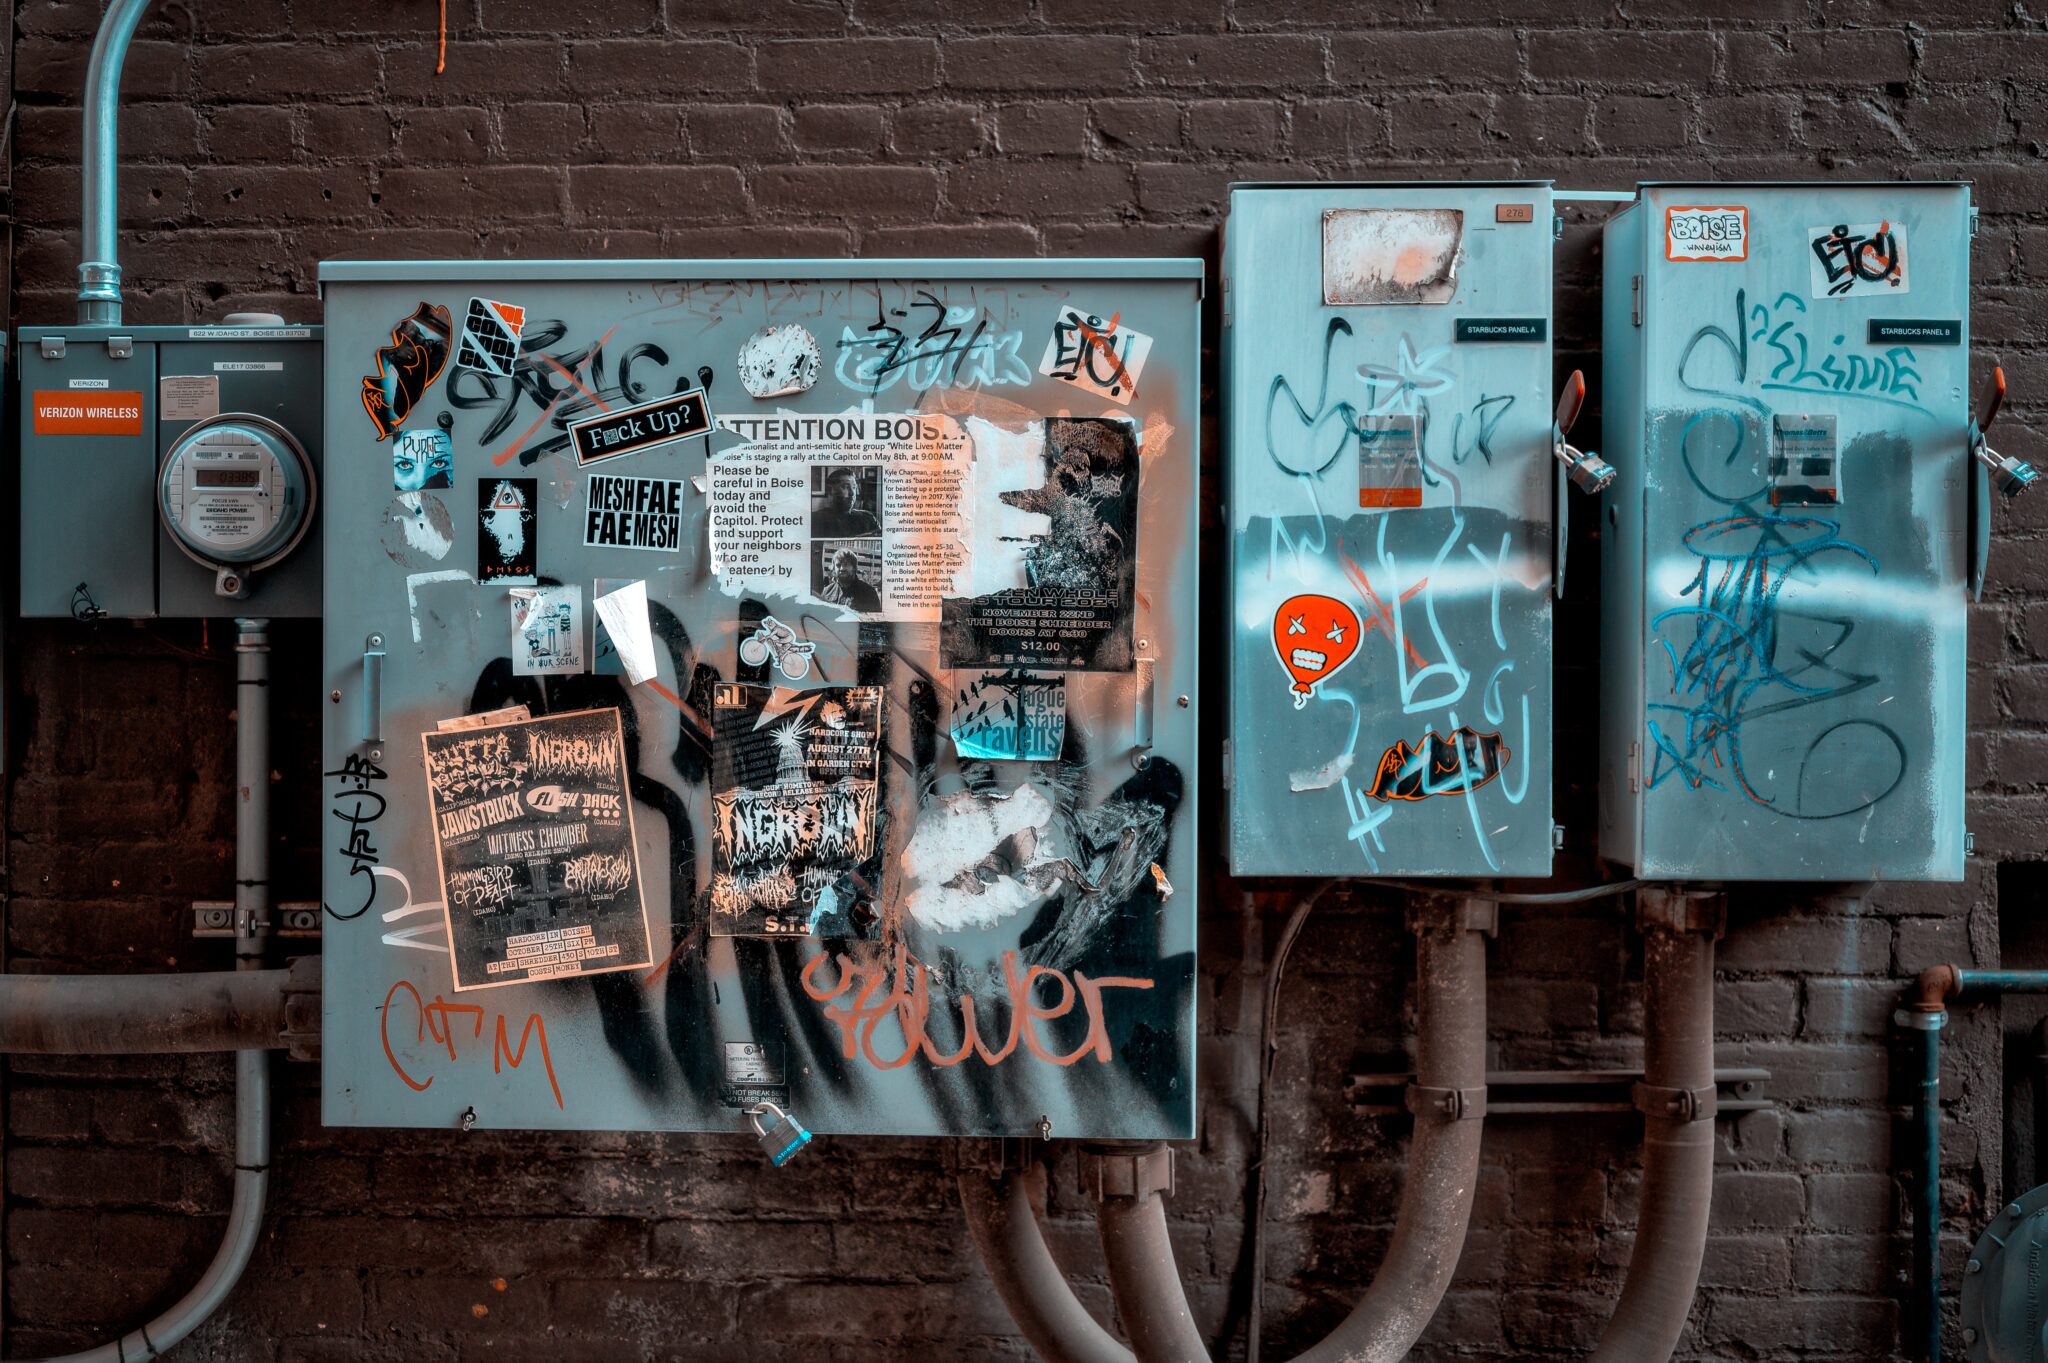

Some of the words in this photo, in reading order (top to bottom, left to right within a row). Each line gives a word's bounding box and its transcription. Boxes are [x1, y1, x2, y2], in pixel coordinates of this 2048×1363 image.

[1507, 209, 1523, 217] 278
[1467, 326, 1508, 334] STARBUCKS
[1508, 326, 1530, 334] PANEL
[1530, 326, 1537, 334] A
[1881, 328, 1921, 336] STARBUCKS
[1922, 328, 1944, 336] PANEL
[1945, 328, 1951, 336] B
[40, 407, 83, 418] VERIZON
[86, 407, 139, 418] WIRELESS
[588, 418, 645, 449] Fck
[646, 404, 691, 435] Up?
[718, 419, 865, 441] TTENTION
[780, 442, 794, 452] and
[796, 442, 842, 452] anti-semitic
[844, 442, 862, 452] hate
[863, 442, 886, 452] group
[888, 442, 913, 452] "White
[915, 442, 934, 452] Lives
[936, 442, 963, 452] Matter
[746, 453, 753, 462] is
[754, 453, 782, 462] staging
[783, 453, 788, 462] a
[790, 453, 806, 462] rally
[808, 453, 816, 462] at
[817, 453, 831, 462] the
[832, 453, 860, 462] Capitol
[862, 453, 873, 462] on
[874, 453, 891, 462] May
[893, 453, 909, 462] 8th,
[910, 453, 919, 462] at
[713, 465, 752, 476] Please
[755, 465, 770, 476] be
[713, 478, 753, 488] careful
[756, 478, 767, 488] in
[770, 478, 804, 488] Boise
[589, 476, 635, 511] MESH
[636, 479, 682, 514] FAE
[713, 490, 746, 502] today
[748, 490, 771, 500] and
[713, 503, 745, 513] avoid
[748, 503, 767, 513] the
[713, 515, 758, 528] Capitol.
[761, 515, 804, 526] Protect
[586, 511, 632, 546] FAE
[633, 513, 680, 549] MESH
[714, 528, 735, 538] and
[738, 528, 784, 540] support
[714, 542, 740, 552] your
[743, 541, 802, 552] neighbors
[714, 552, 737, 562] who
[740, 552, 759, 562] are
[778, 565, 793, 577] by
[993, 598, 1058, 607] TOUR
[982, 609, 1057, 618] NOVEMBER
[1059, 609, 1095, 618] 22ND
[966, 618, 993, 628] THE
[995, 618, 1037, 628] BOISE
[1039, 618, 1112, 628] SHREDDER
[988, 628, 1036, 637] DOORS
[1037, 628, 1057, 637] AT
[1021, 641, 1061, 651] $12.00
[556, 657, 580, 667] SCENE
[1026, 711, 1065, 730] state
[980, 725, 1060, 753] ravens
[807, 744, 846, 753] AUGUST
[846, 745, 871, 754] 27TH
[526, 729, 618, 782] INGROWN
[817, 760, 850, 768] GARDEN
[851, 760, 872, 768] CITY
[783, 788, 814, 797] RELEASE
[581, 794, 622, 809] BACK
[441, 791, 525, 840] JAWSTRUCK
[713, 784, 873, 868] INGROWN
[487, 829, 535, 855] WITNESS
[540, 823, 589, 848] CHAMBER
[454, 888, 470, 909] OF
[508, 934, 546, 945] HARDCORE
[507, 946, 541, 956] OCTOBER
[544, 943, 564, 951] 25TH
[566, 940, 580, 948] SIX
[584, 937, 595, 945] PM
[501, 960, 516, 969] THE
[519, 954, 558, 967] SHREDDER
[529, 967, 552, 976] COSTS
[555, 963, 580, 972] MONEY
